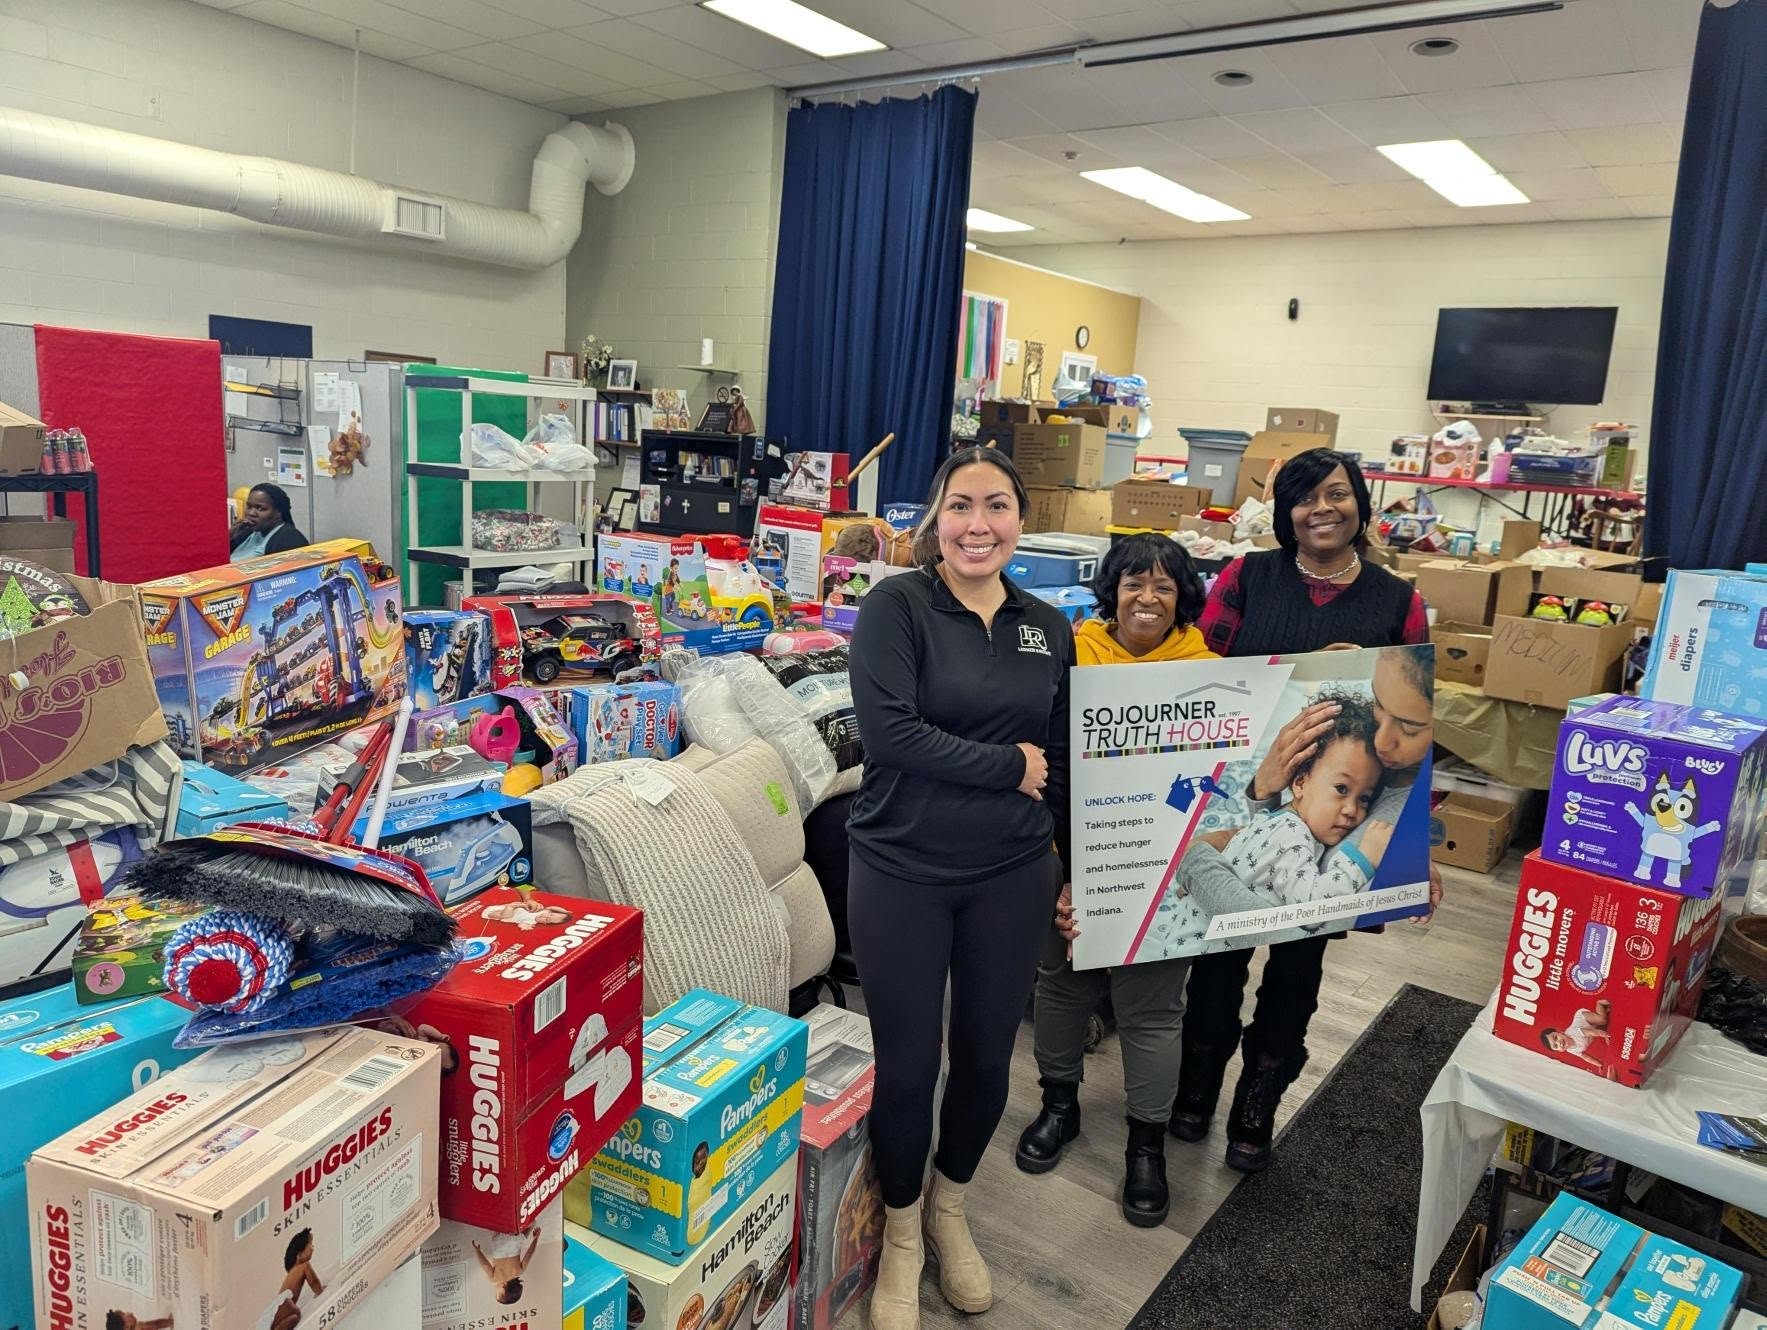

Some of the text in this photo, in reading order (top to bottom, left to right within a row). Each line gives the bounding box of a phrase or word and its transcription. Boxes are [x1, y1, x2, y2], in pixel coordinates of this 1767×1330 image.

[886, 508, 915, 523] Oster
[0, 559, 63, 592] stmas
[144, 605, 171, 615] NSTER
[203, 597, 245, 615] MONSTER
[216, 608, 235, 619] JAM
[147, 632, 175, 646] RAGE
[204, 624, 250, 660] GARAGE
[1668, 632, 1681, 662] meijer
[1680, 627, 1698, 672] diapers
[645, 700, 656, 749] DOCTOR
[657, 703, 666, 718] Get
[1083, 701, 1216, 728] SOJOURNER
[635, 708, 643, 746] Play Set
[1083, 718, 1250, 749] TRUTH HOUSE
[1592, 773, 1641, 787] protection
[1685, 757, 1724, 775] BLUEY
[1085, 793, 1157, 807] UNLOCK HOPE:
[1085, 816, 1154, 831] Taking steps to
[382, 835, 438, 854] Hamilton
[415, 839, 453, 857] Beach
[1085, 838, 1152, 852] reduce hunger
[1560, 840, 1571, 850] 4
[1573, 852, 1585, 861] 84
[1086, 858, 1169, 875] and homelessness
[1086, 883, 1145, 896] in Northwest
[1639, 898, 1658, 910] 3
[1086, 907, 1124, 917] Indiana.
[1216, 889, 1423, 931] A ministry of the Poor Handmaids of Jesus Christ
[1635, 911, 1649, 929] 136
[501, 913, 614, 982] HUGGIES
[1503, 888, 1558, 1026] HUGGIES
[1546, 907, 1574, 991] little movers
[19, 1020, 114, 1054] Pampers
[677, 1053, 720, 1082] Pampers
[468, 1035, 500, 1194] HUGGIES
[721, 1078, 777, 1139] Pampers
[75, 1092, 188, 1156] HUGGIES
[90, 1135, 129, 1164] SKIN
[129, 1091, 210, 1142] ESSENTIALS
[726, 1112, 768, 1154] swaddlers
[283, 1106, 393, 1212] HUGGIES
[448, 1117, 461, 1185] snugglers
[459, 1140, 468, 1165] little
[603, 1136, 662, 1169] mpers
[274, 1126, 403, 1237] SKIN ESSENTIALS
[366, 1166, 390, 1191] protect
[391, 1148, 414, 1169] against
[592, 1157, 651, 1186] swaddlers
[519, 1149, 579, 1223] HUGGIES
[603, 1181, 632, 1198] protection
[661, 1186, 666, 1198] 1
[175, 1212, 193, 1229] 4
[426, 1201, 435, 1220] 4
[744, 1193, 790, 1255] Beach
[656, 1224, 667, 1234] 96
[701, 1193, 774, 1284] Hamilton
[72, 1195, 88, 1306] ESSENTIALS
[50, 1204, 73, 1330] HUGGIES
[336, 1278, 365, 1309] DIAPERS
[336, 1281, 370, 1314] COUCHES
[1633, 1290, 1673, 1326] Pampers
[319, 1305, 336, 1330] 58
[501, 1308, 537, 1323] SKIN
